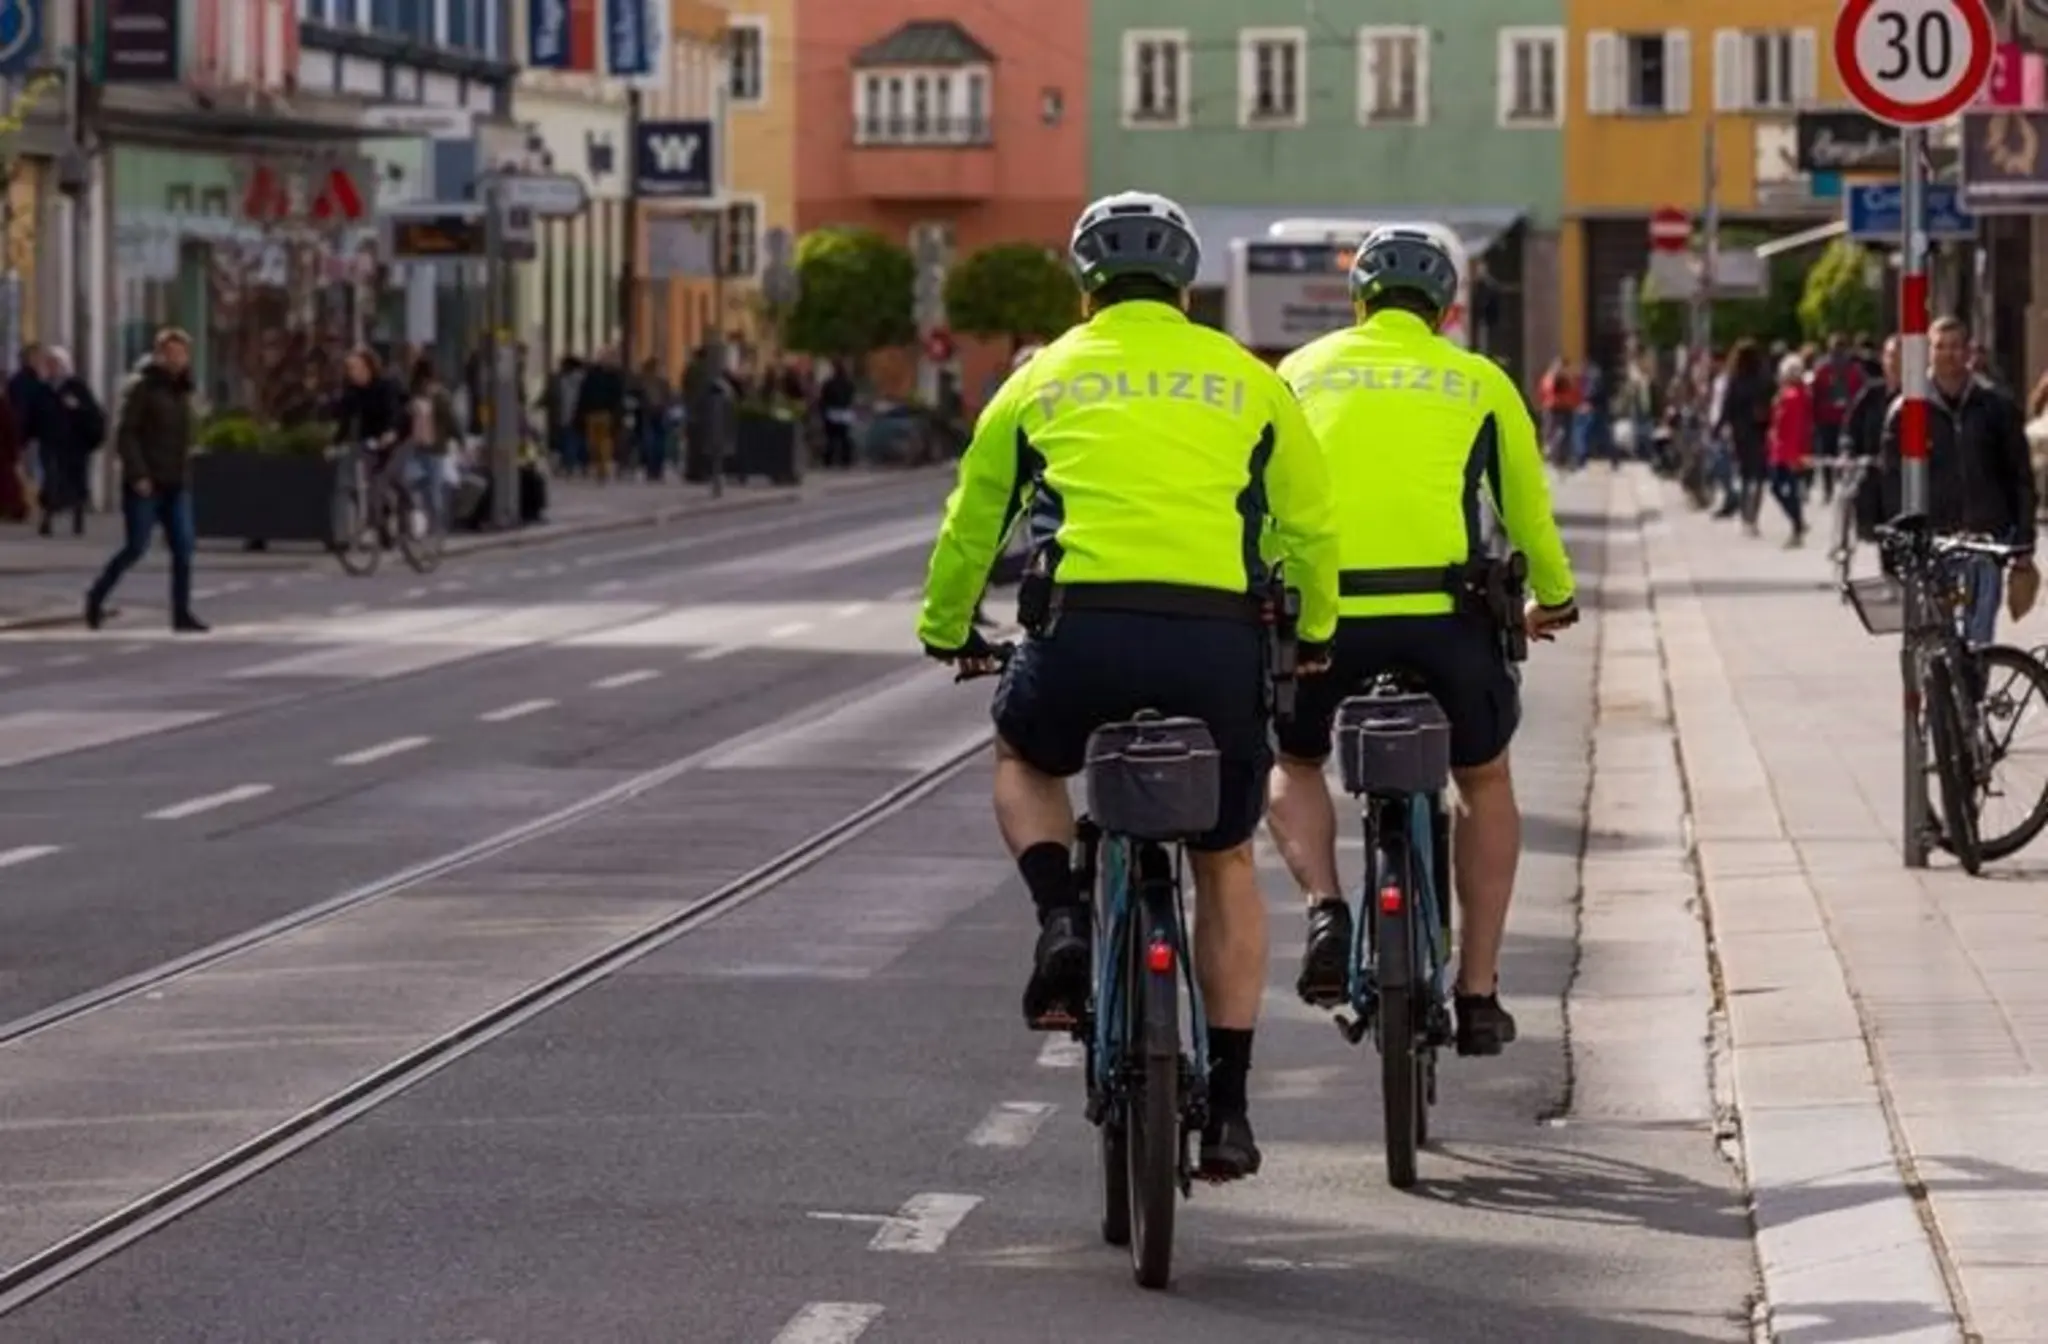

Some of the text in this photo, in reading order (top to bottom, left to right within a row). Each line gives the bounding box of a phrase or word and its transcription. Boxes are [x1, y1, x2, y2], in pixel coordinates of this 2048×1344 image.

[1876, 10, 1952, 80] 30
[1038, 370, 1244, 421] POLIZEI
[1297, 364, 1480, 408] POLIZEI
